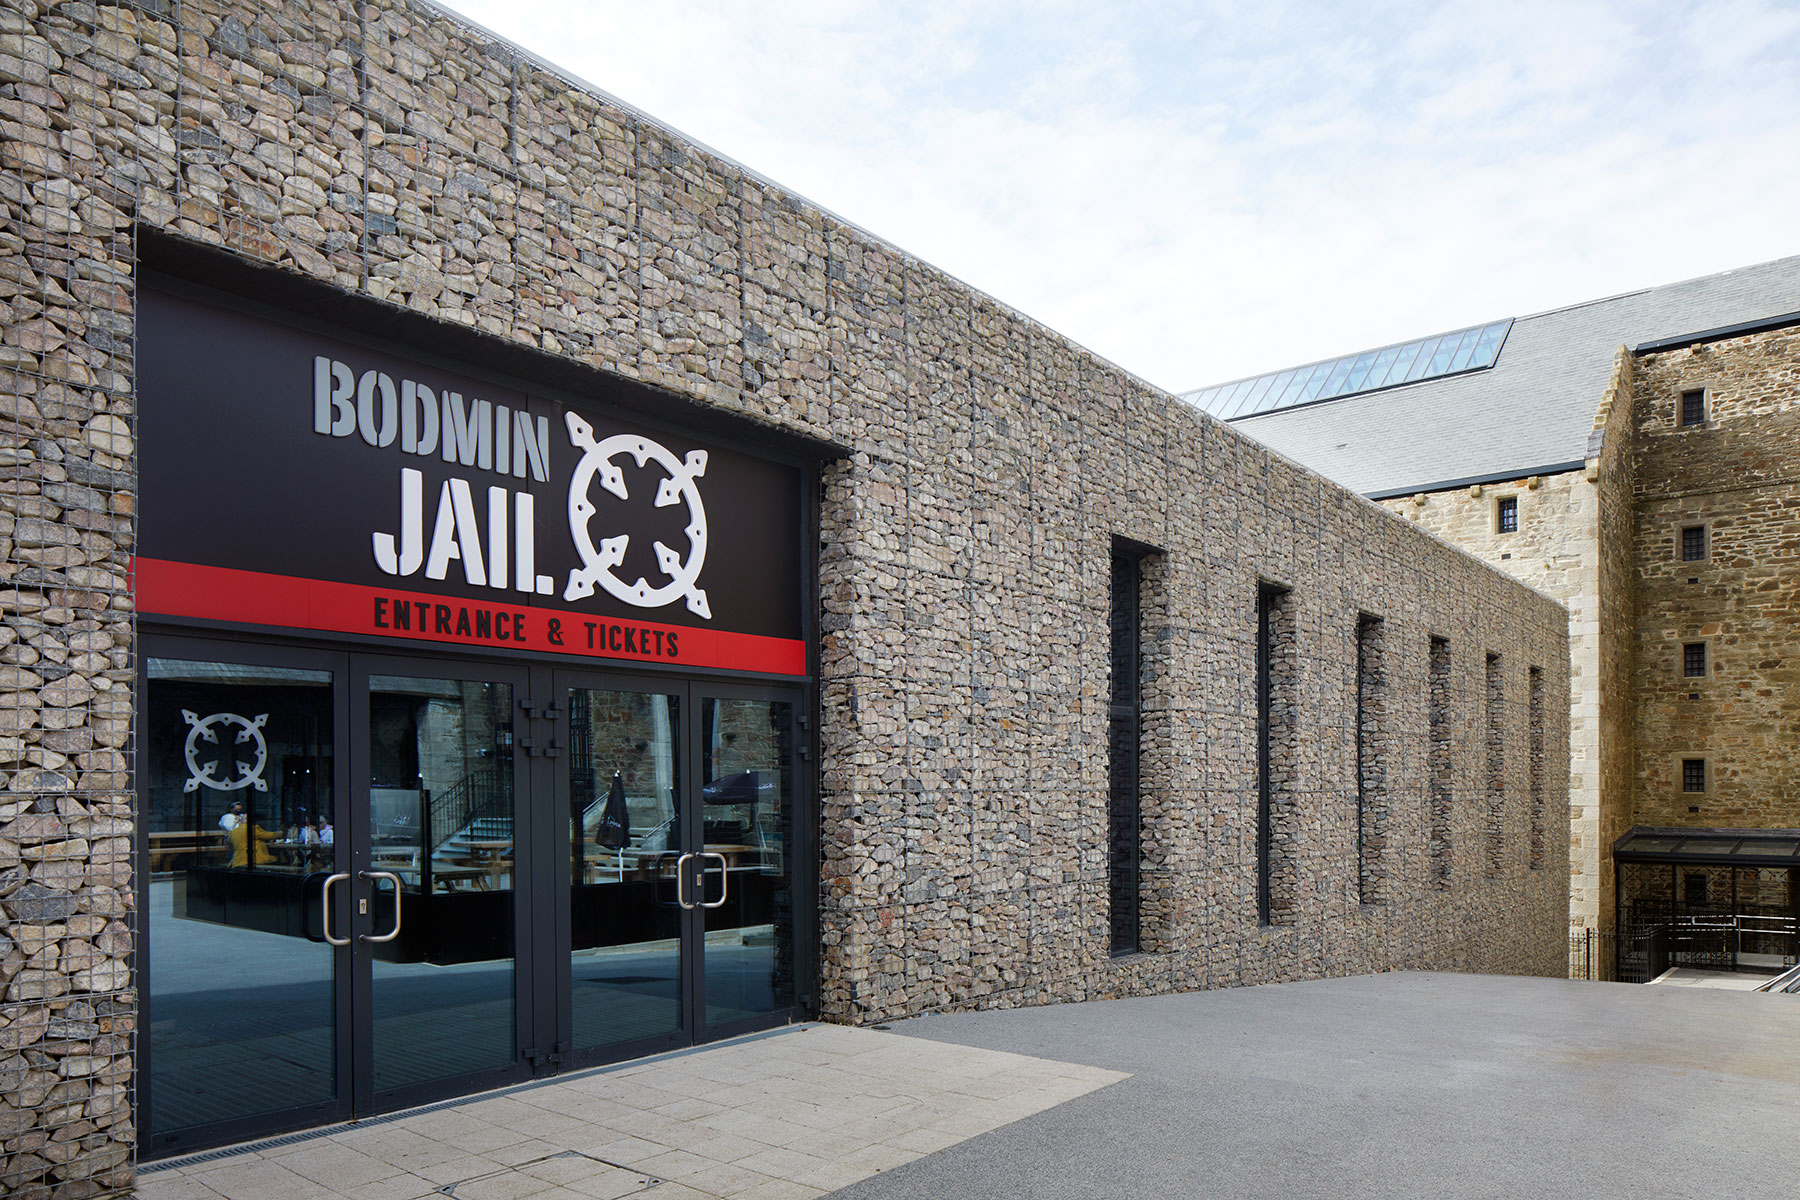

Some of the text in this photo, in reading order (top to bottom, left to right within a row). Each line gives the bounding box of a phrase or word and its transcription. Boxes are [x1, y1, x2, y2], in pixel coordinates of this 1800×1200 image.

[314, 356, 550, 482] BODMIN
[372, 467, 554, 596] JAIL
[374, 597, 680, 658] ENTRANCE & TICKETS
